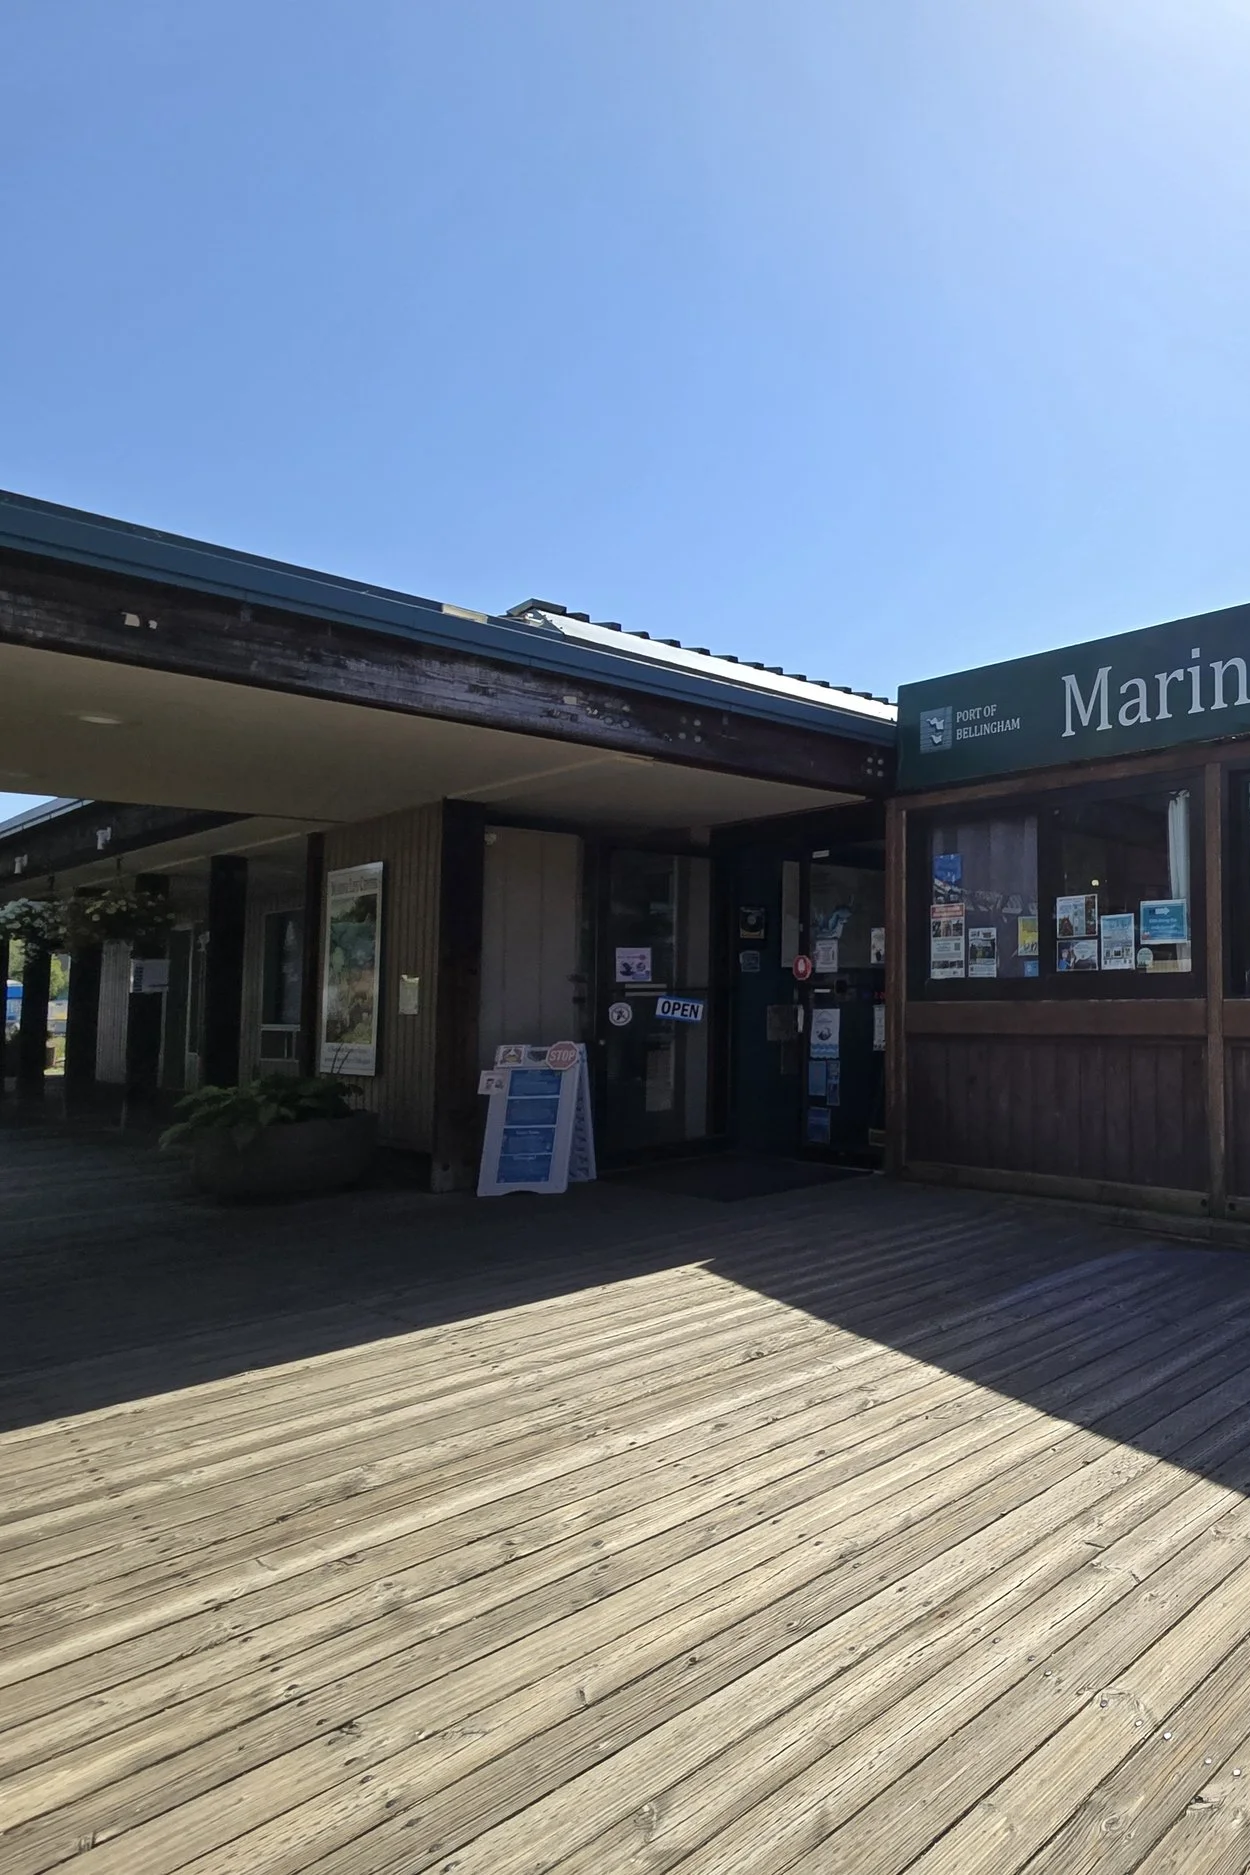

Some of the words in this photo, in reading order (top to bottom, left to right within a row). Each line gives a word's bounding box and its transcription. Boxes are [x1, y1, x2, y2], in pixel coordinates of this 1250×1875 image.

[956, 707, 983, 723] PORT
[983, 704, 998, 717] OF
[956, 716, 1021, 741] BELLINGHAM
[661, 1000, 700, 1018] OPEN
[549, 1048, 575, 1062] STOP
